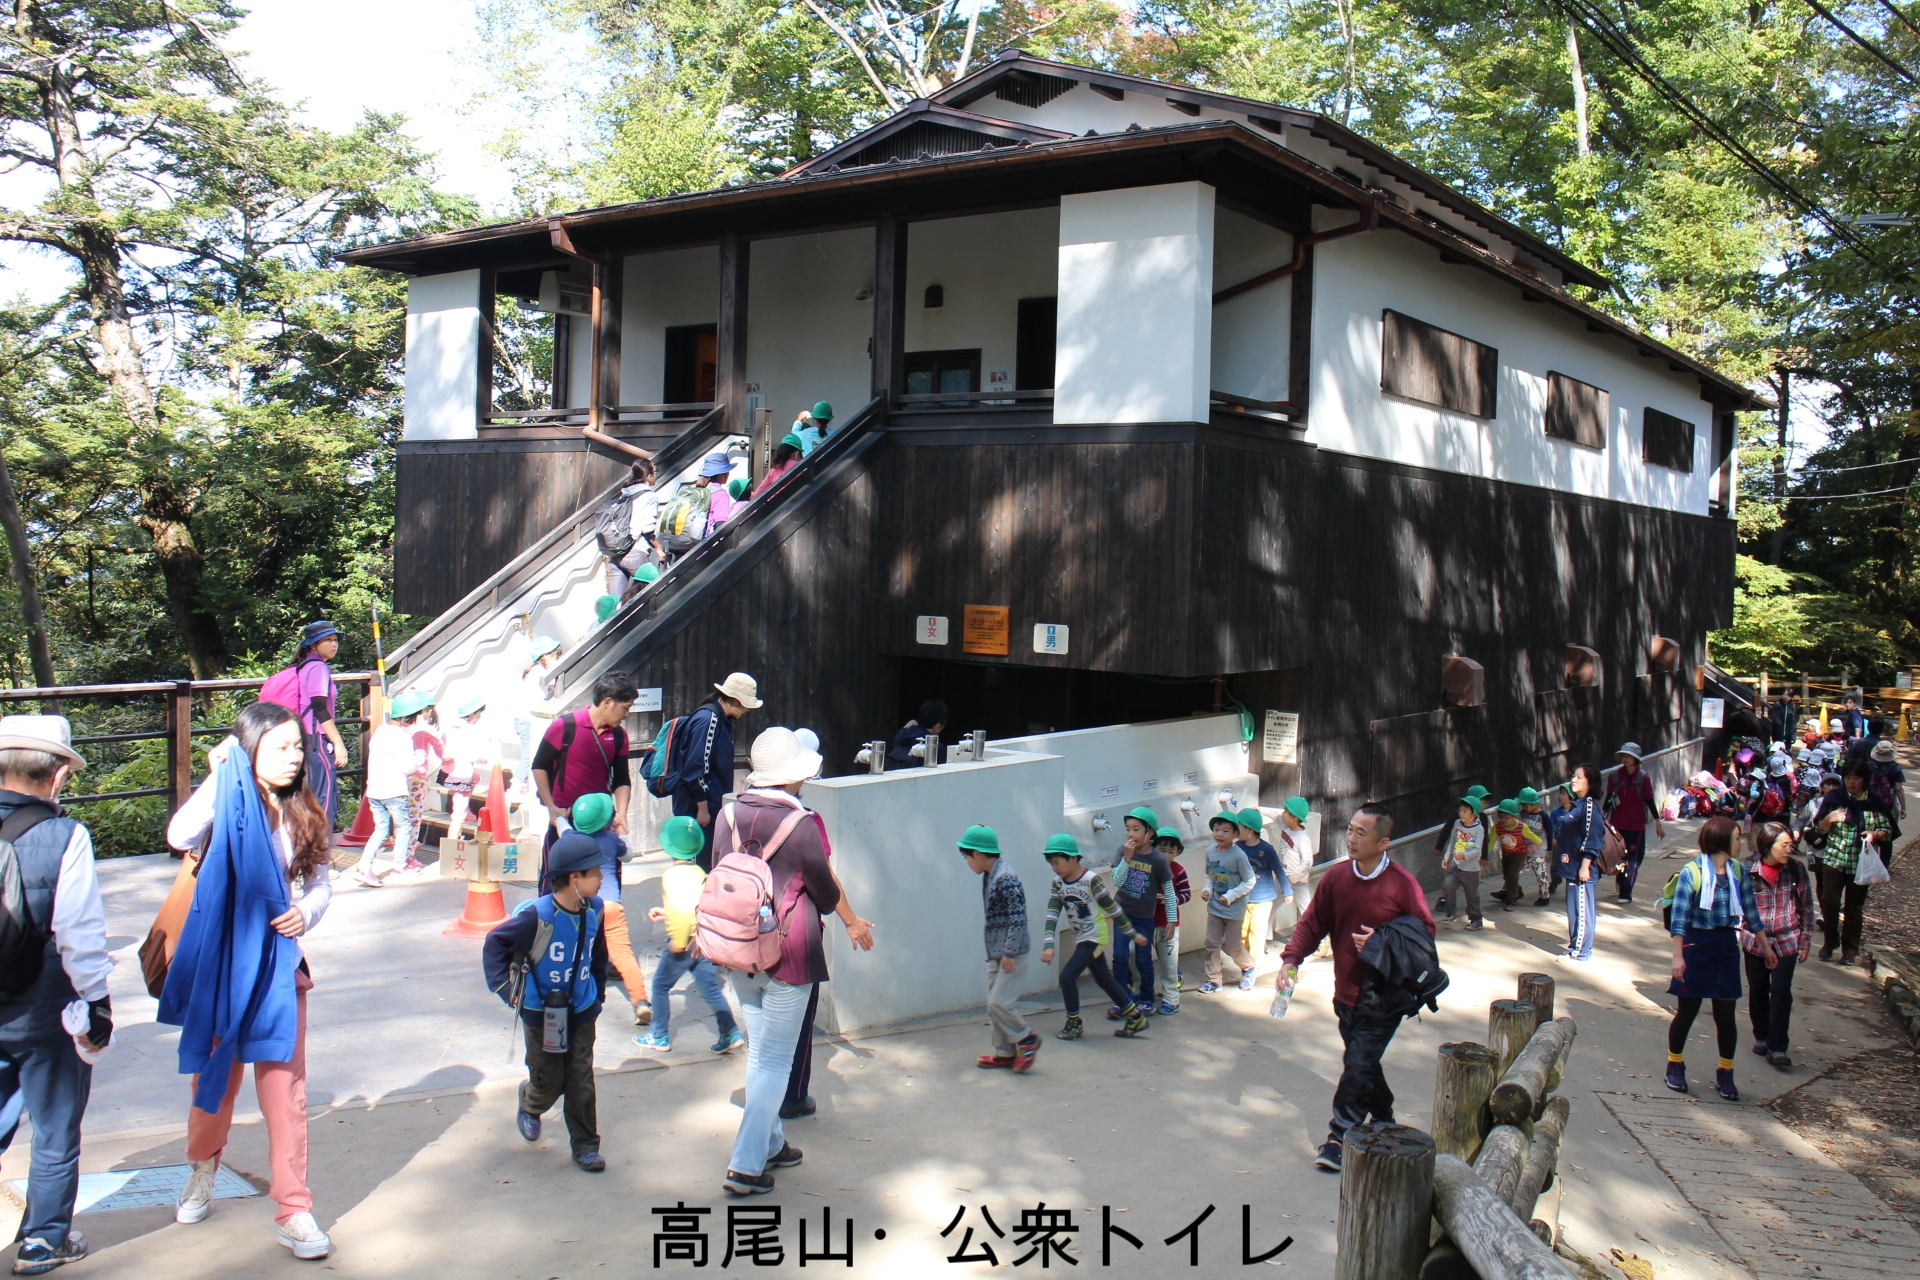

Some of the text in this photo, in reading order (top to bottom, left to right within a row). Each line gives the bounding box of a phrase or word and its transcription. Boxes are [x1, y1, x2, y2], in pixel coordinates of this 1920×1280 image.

[927, 625, 937, 637] 女
[1045, 635, 1056, 648] 男
[454, 855, 466, 871] 女
[502, 858, 518, 874] 男
[549, 966, 590, 982] SPC
